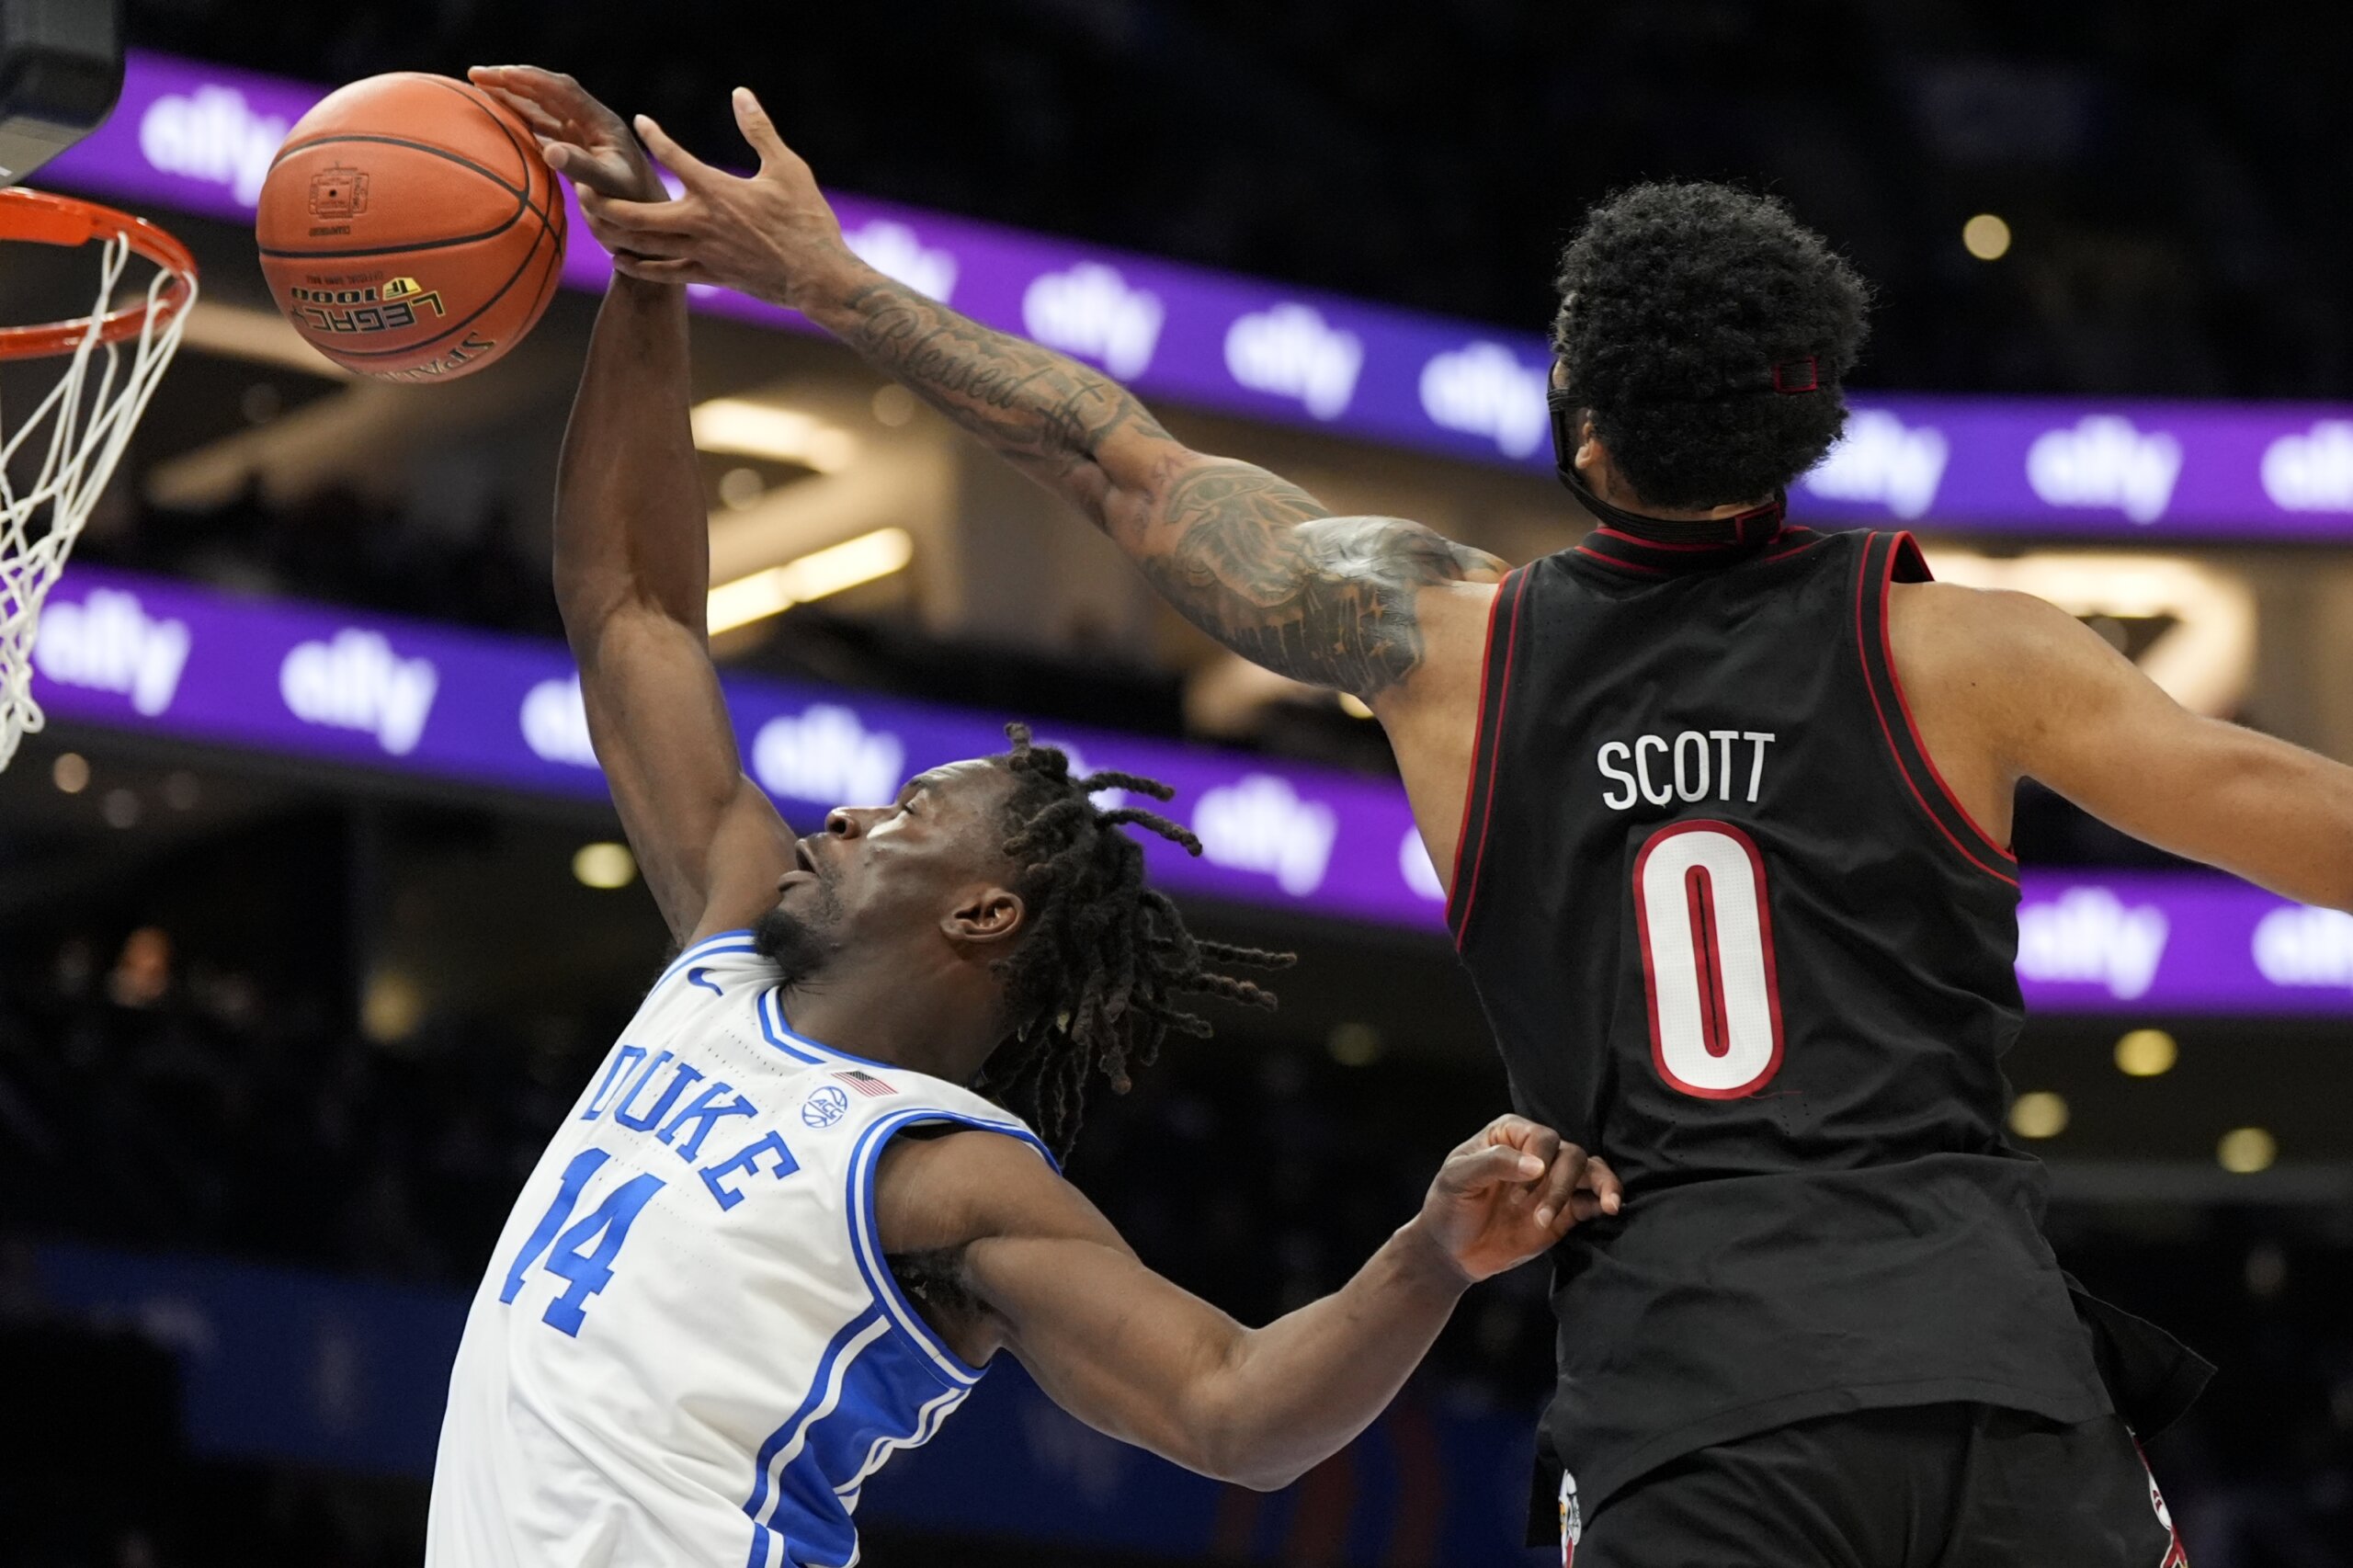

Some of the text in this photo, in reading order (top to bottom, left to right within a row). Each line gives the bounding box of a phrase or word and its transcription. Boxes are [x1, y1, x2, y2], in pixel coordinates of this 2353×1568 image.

[290, 287, 379, 304] 1000
[290, 290, 446, 334] LEGACY
[1597, 731, 1775, 810] SCOTT
[1632, 819, 1784, 1100] 0
[581, 1045, 801, 1212] DUKE
[499, 1147, 665, 1338] 14
